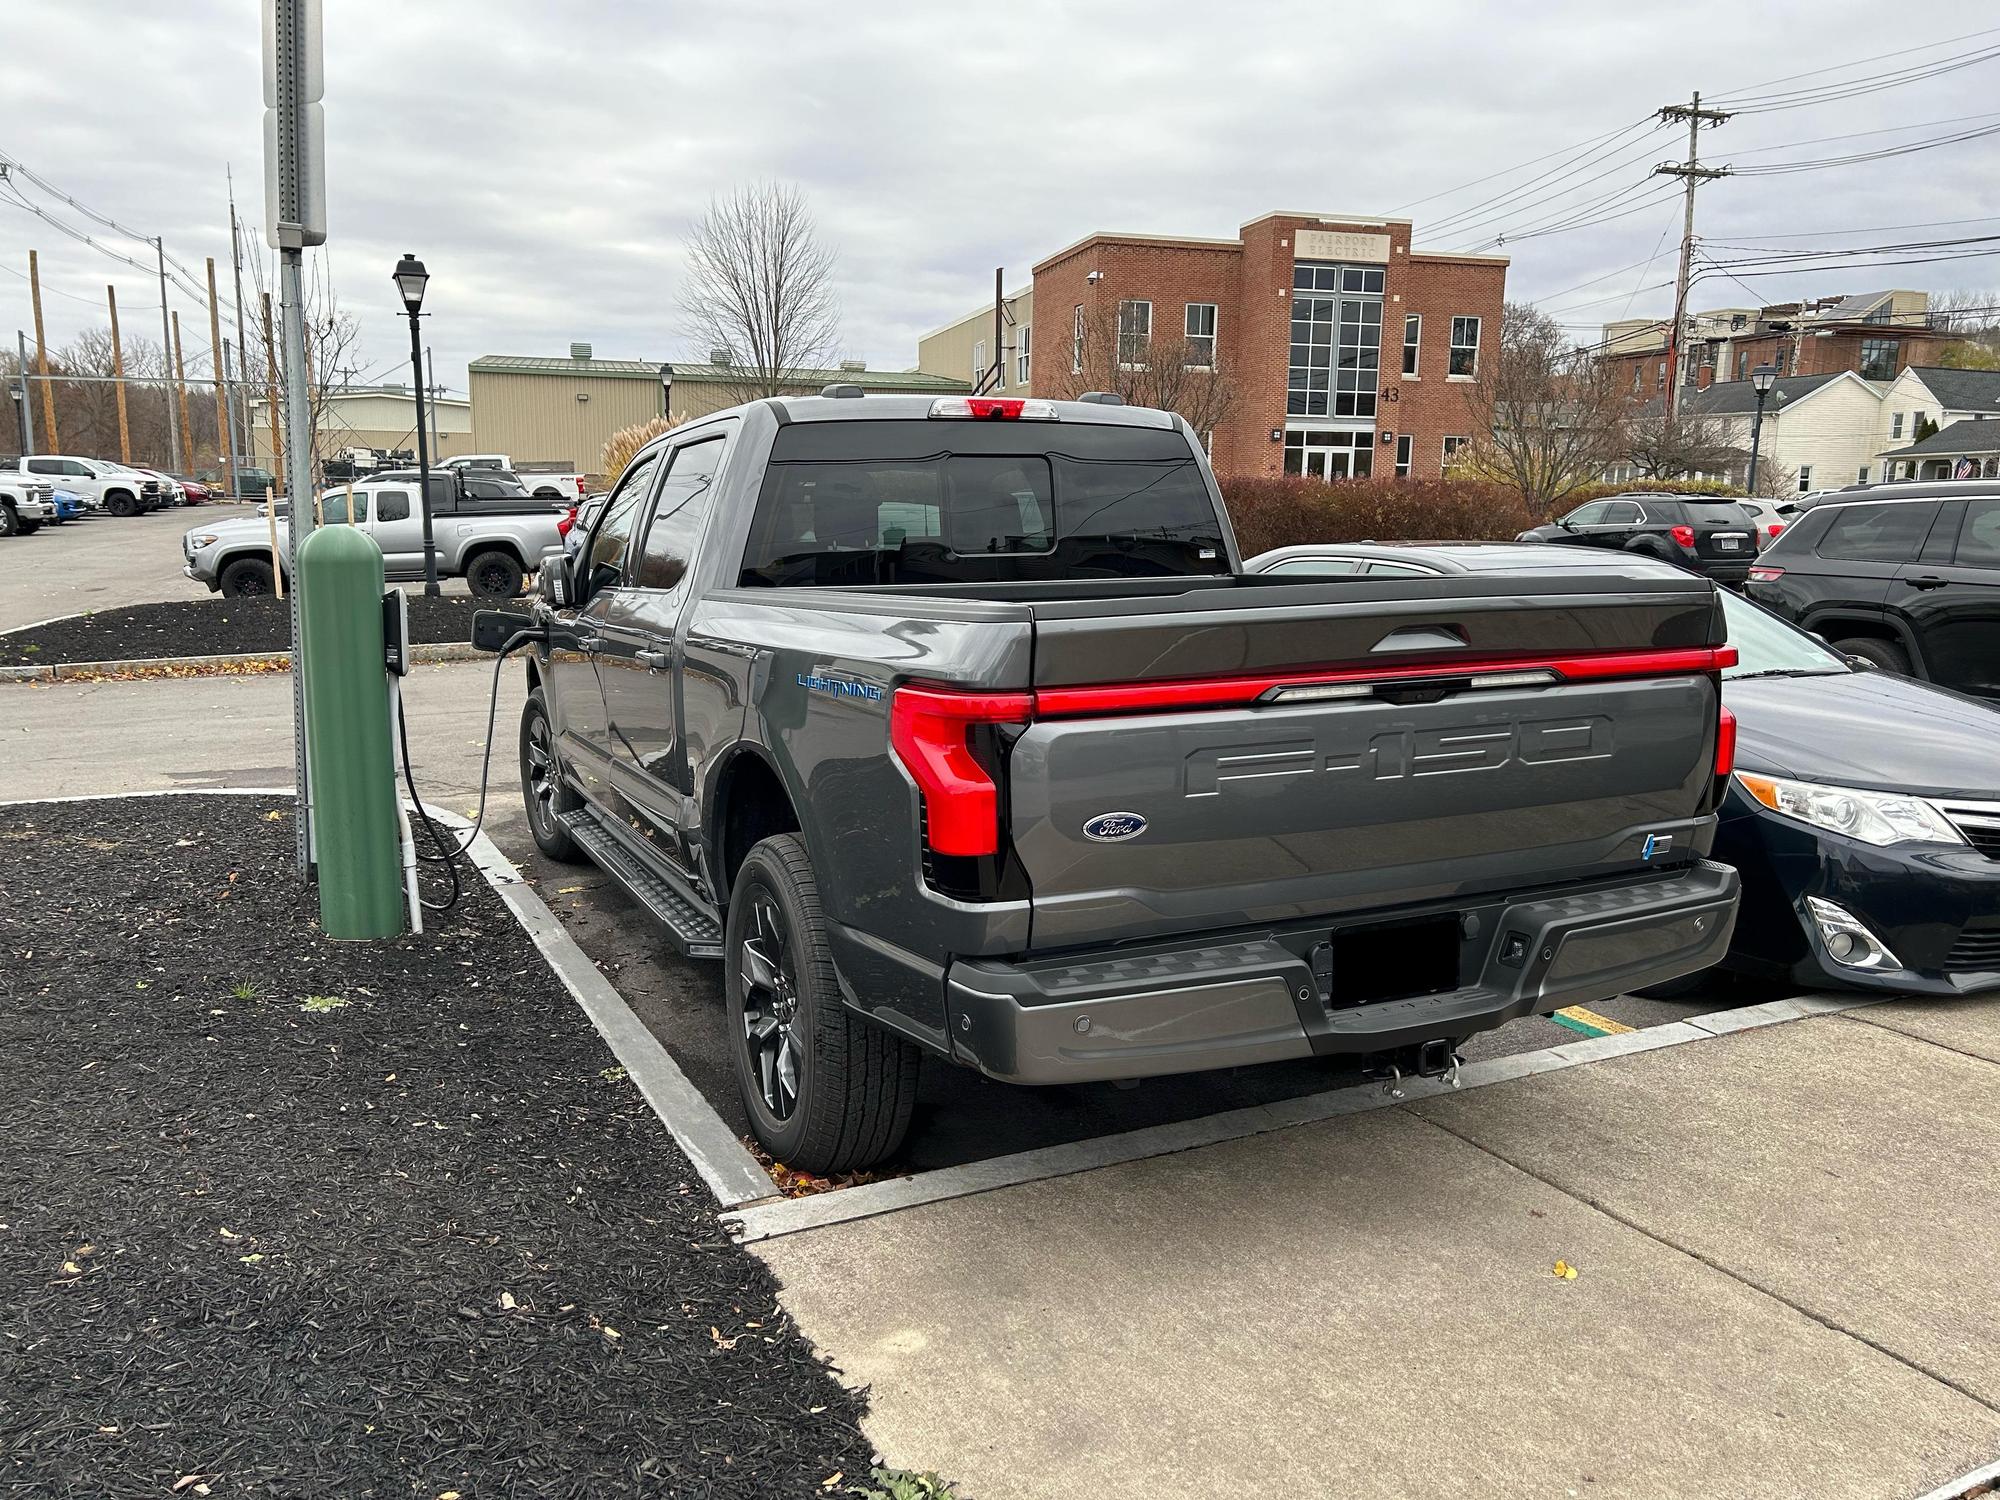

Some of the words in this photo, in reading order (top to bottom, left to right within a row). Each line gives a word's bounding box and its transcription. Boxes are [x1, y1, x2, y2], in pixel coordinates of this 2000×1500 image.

[1309, 233, 1377, 247] FAIRPORT
[1309, 245, 1377, 258] ELECTRIC
[1381, 387, 1399, 402] 43
[797, 673, 882, 700] LIGHTNING
[1184, 714, 1614, 798] F-150
[1099, 818, 1134, 836] Ford
